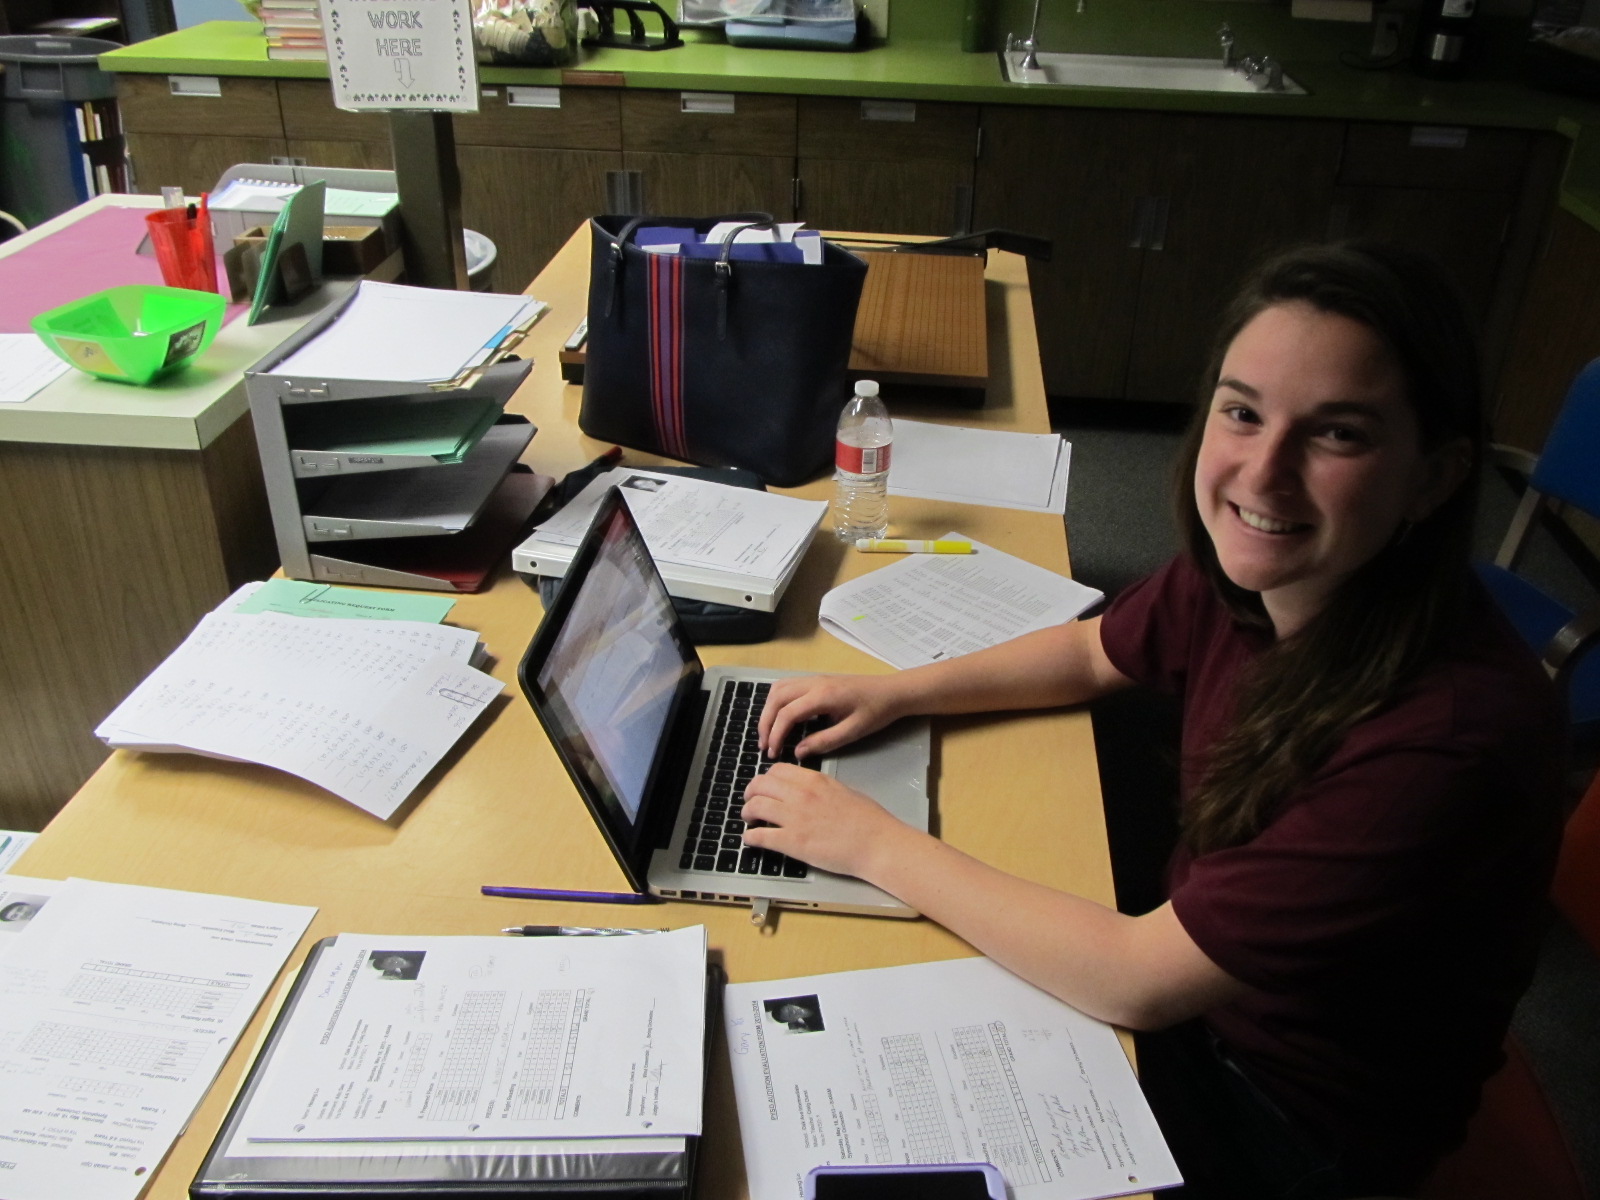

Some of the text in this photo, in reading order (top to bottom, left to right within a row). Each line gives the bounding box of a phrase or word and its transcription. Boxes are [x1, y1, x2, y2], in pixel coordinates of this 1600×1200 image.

[367, 11, 423, 29] WORK
[376, 39, 422, 56] HERE
[759, 1040, 769, 1074] EVALUATION
[765, 1075, 774, 1102] AUDITION
